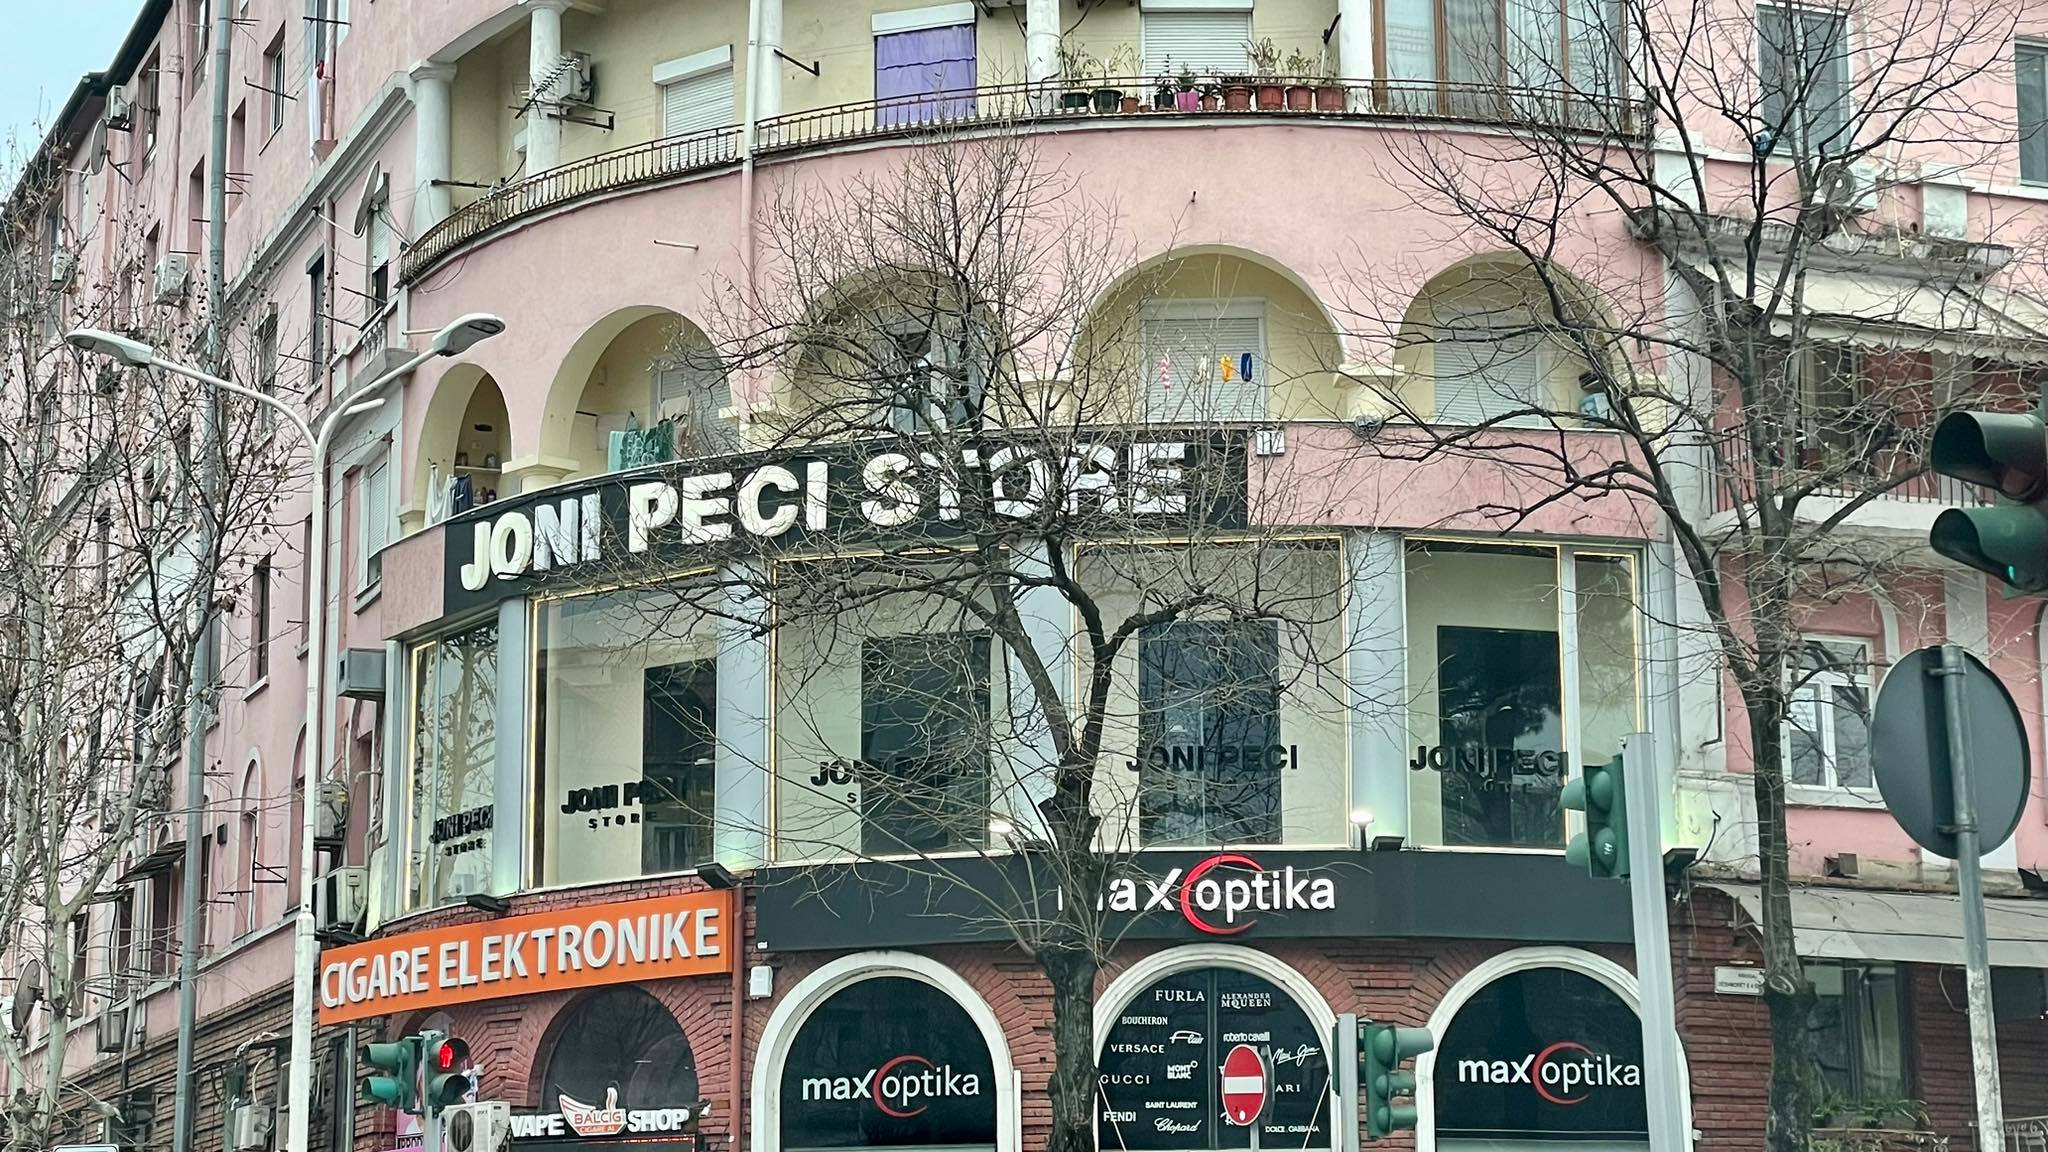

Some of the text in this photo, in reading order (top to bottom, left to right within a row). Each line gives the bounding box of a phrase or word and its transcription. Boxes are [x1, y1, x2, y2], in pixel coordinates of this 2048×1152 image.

[460, 442, 1187, 591] JONI PECI STORE
[1126, 745, 1297, 772] JONI PECI
[561, 785, 618, 814] JONI
[320, 908, 721, 1008] CIGARE ELEKTRONIKE
[1155, 990, 1205, 1001] FURLA
[1122, 1016, 1168, 1025] BOUCHERON
[1223, 1032, 1248, 1042] roberto
[1111, 1044, 1165, 1053] VERSACE
[1100, 1075, 1150, 1084] GUCCI
[510, 1109, 690, 1137] VAPE SHOP
[574, 1111, 622, 1124] BALCIG
[1103, 1111, 1136, 1122] FENDI
[1154, 1117, 1202, 1134] Chopard
